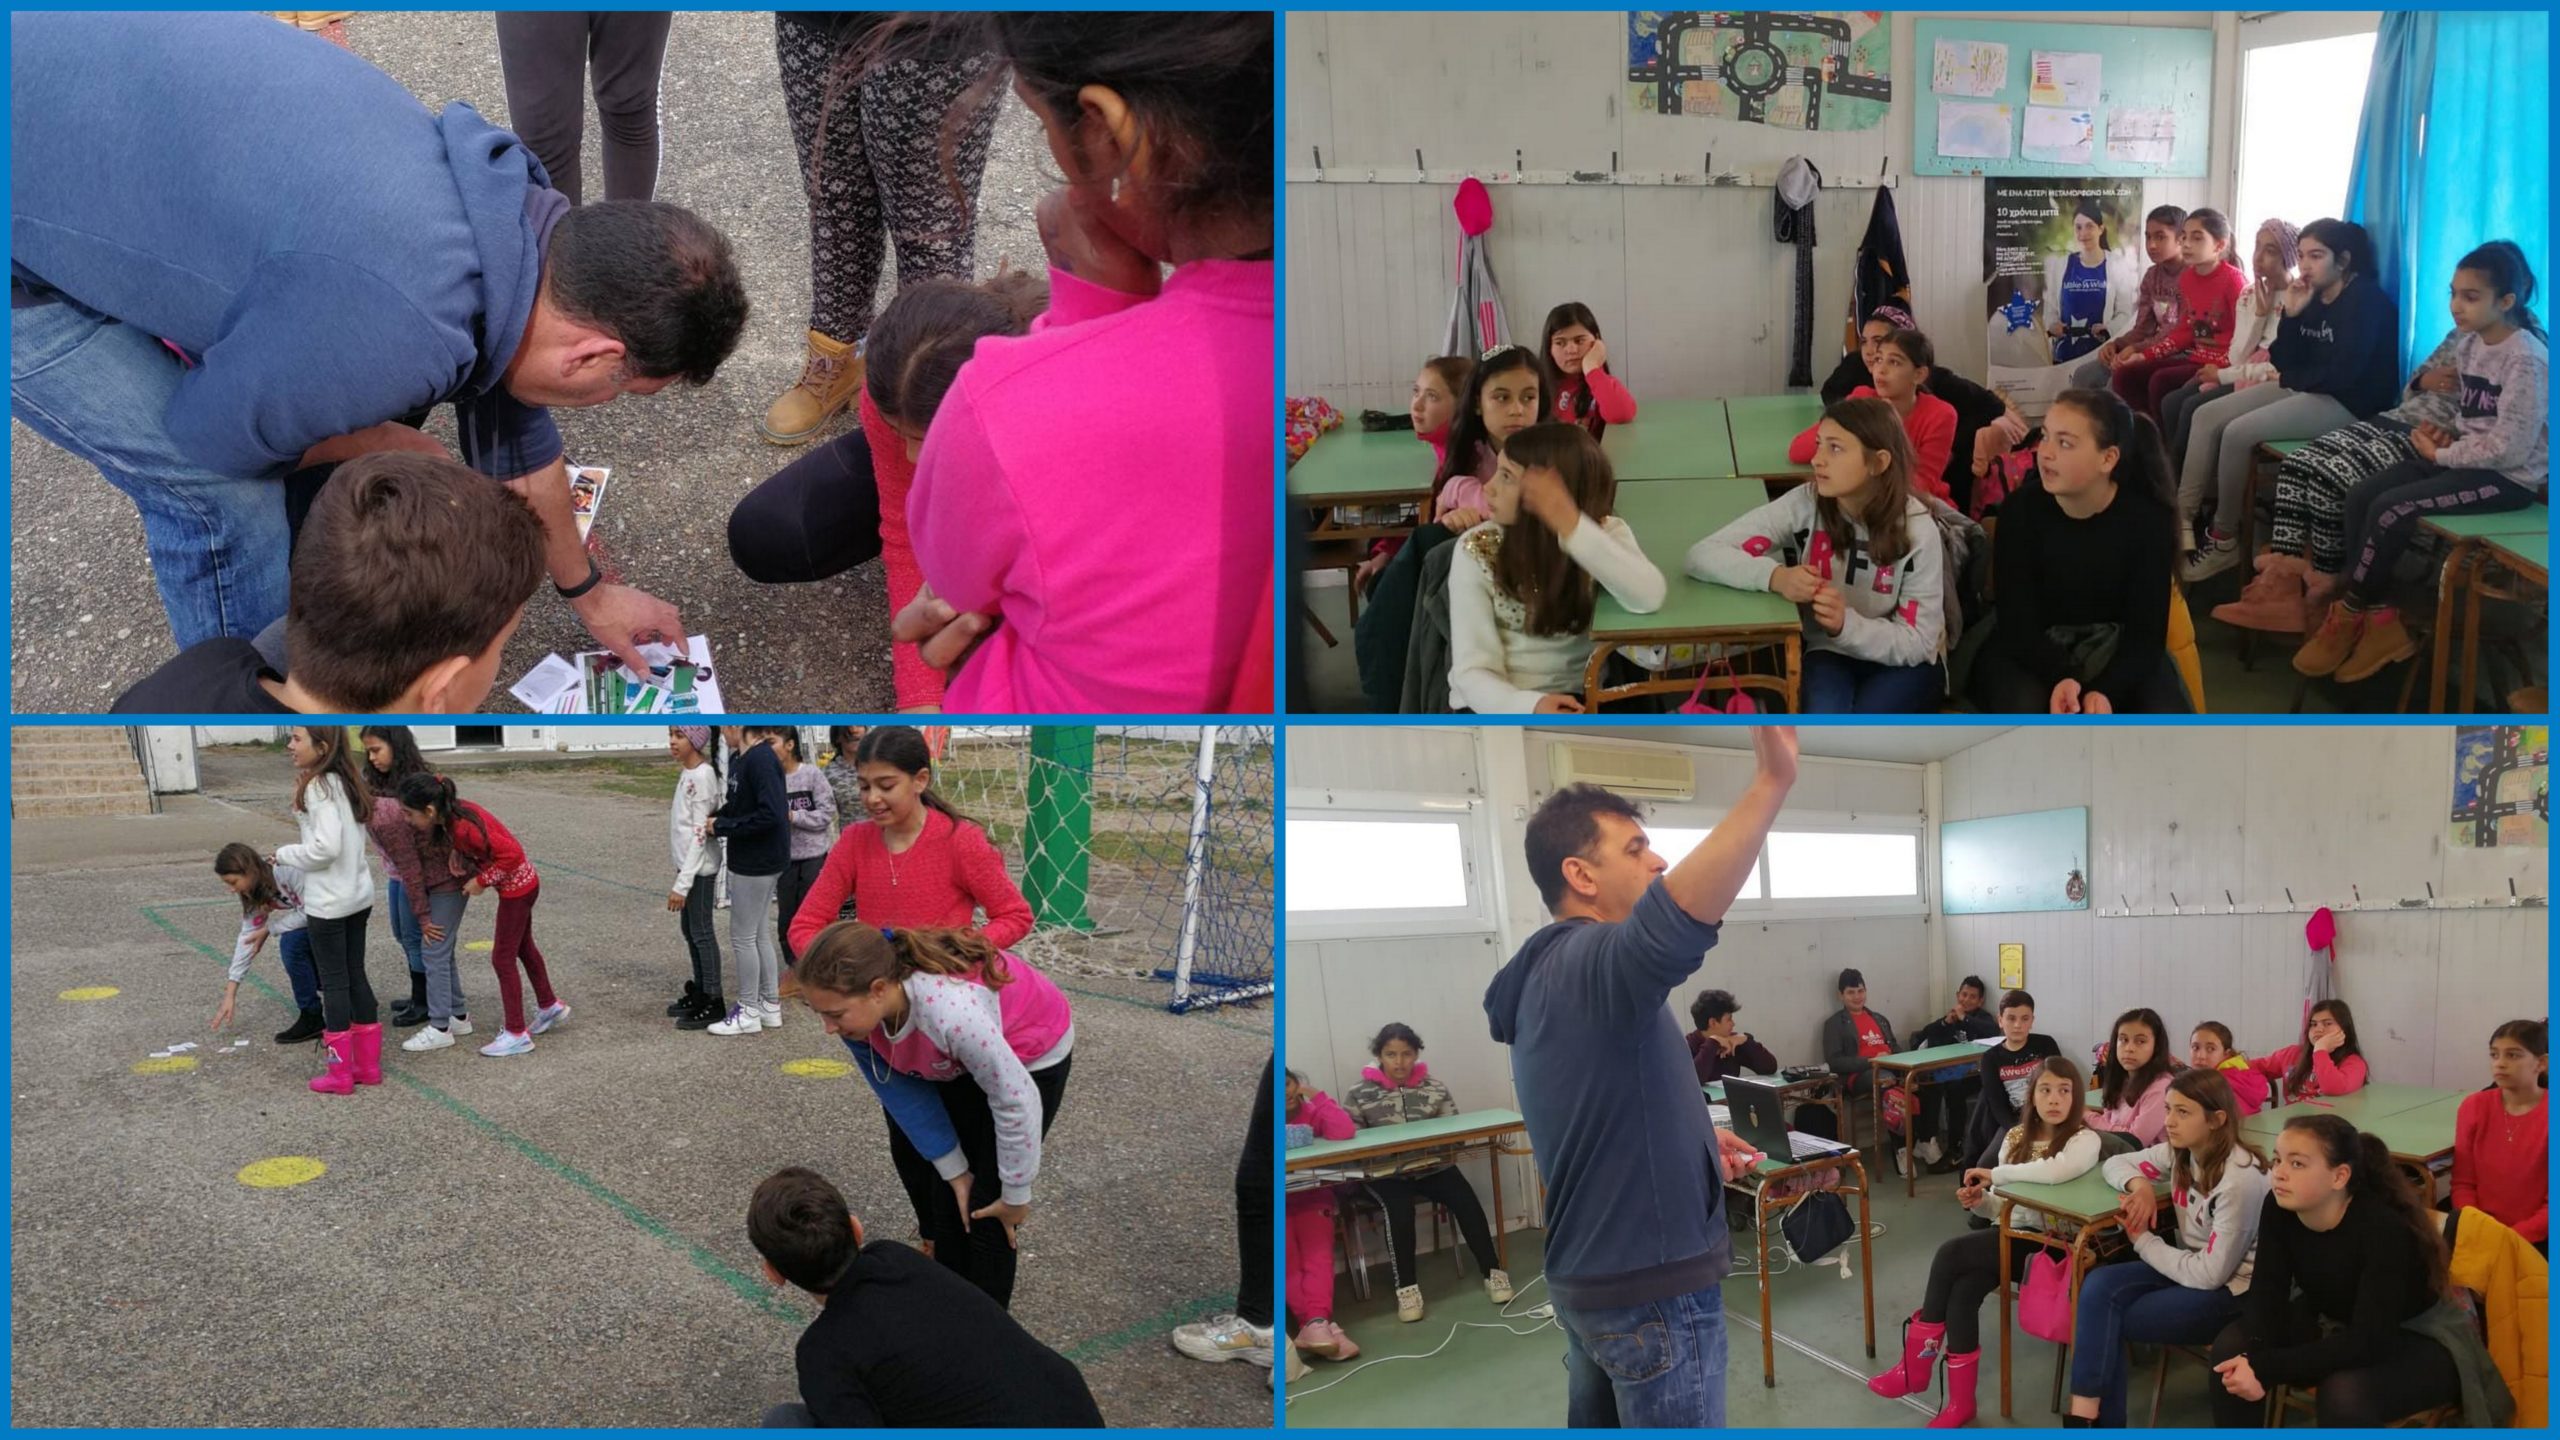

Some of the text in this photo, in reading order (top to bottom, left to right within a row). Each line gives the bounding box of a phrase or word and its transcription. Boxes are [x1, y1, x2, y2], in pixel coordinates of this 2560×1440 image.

[1996, 189, 2008, 197] ΜΕ
[2008, 189, 2023, 197] ΕΝΑ
[1997, 206, 2060, 218] 10 χρόνια μετά
